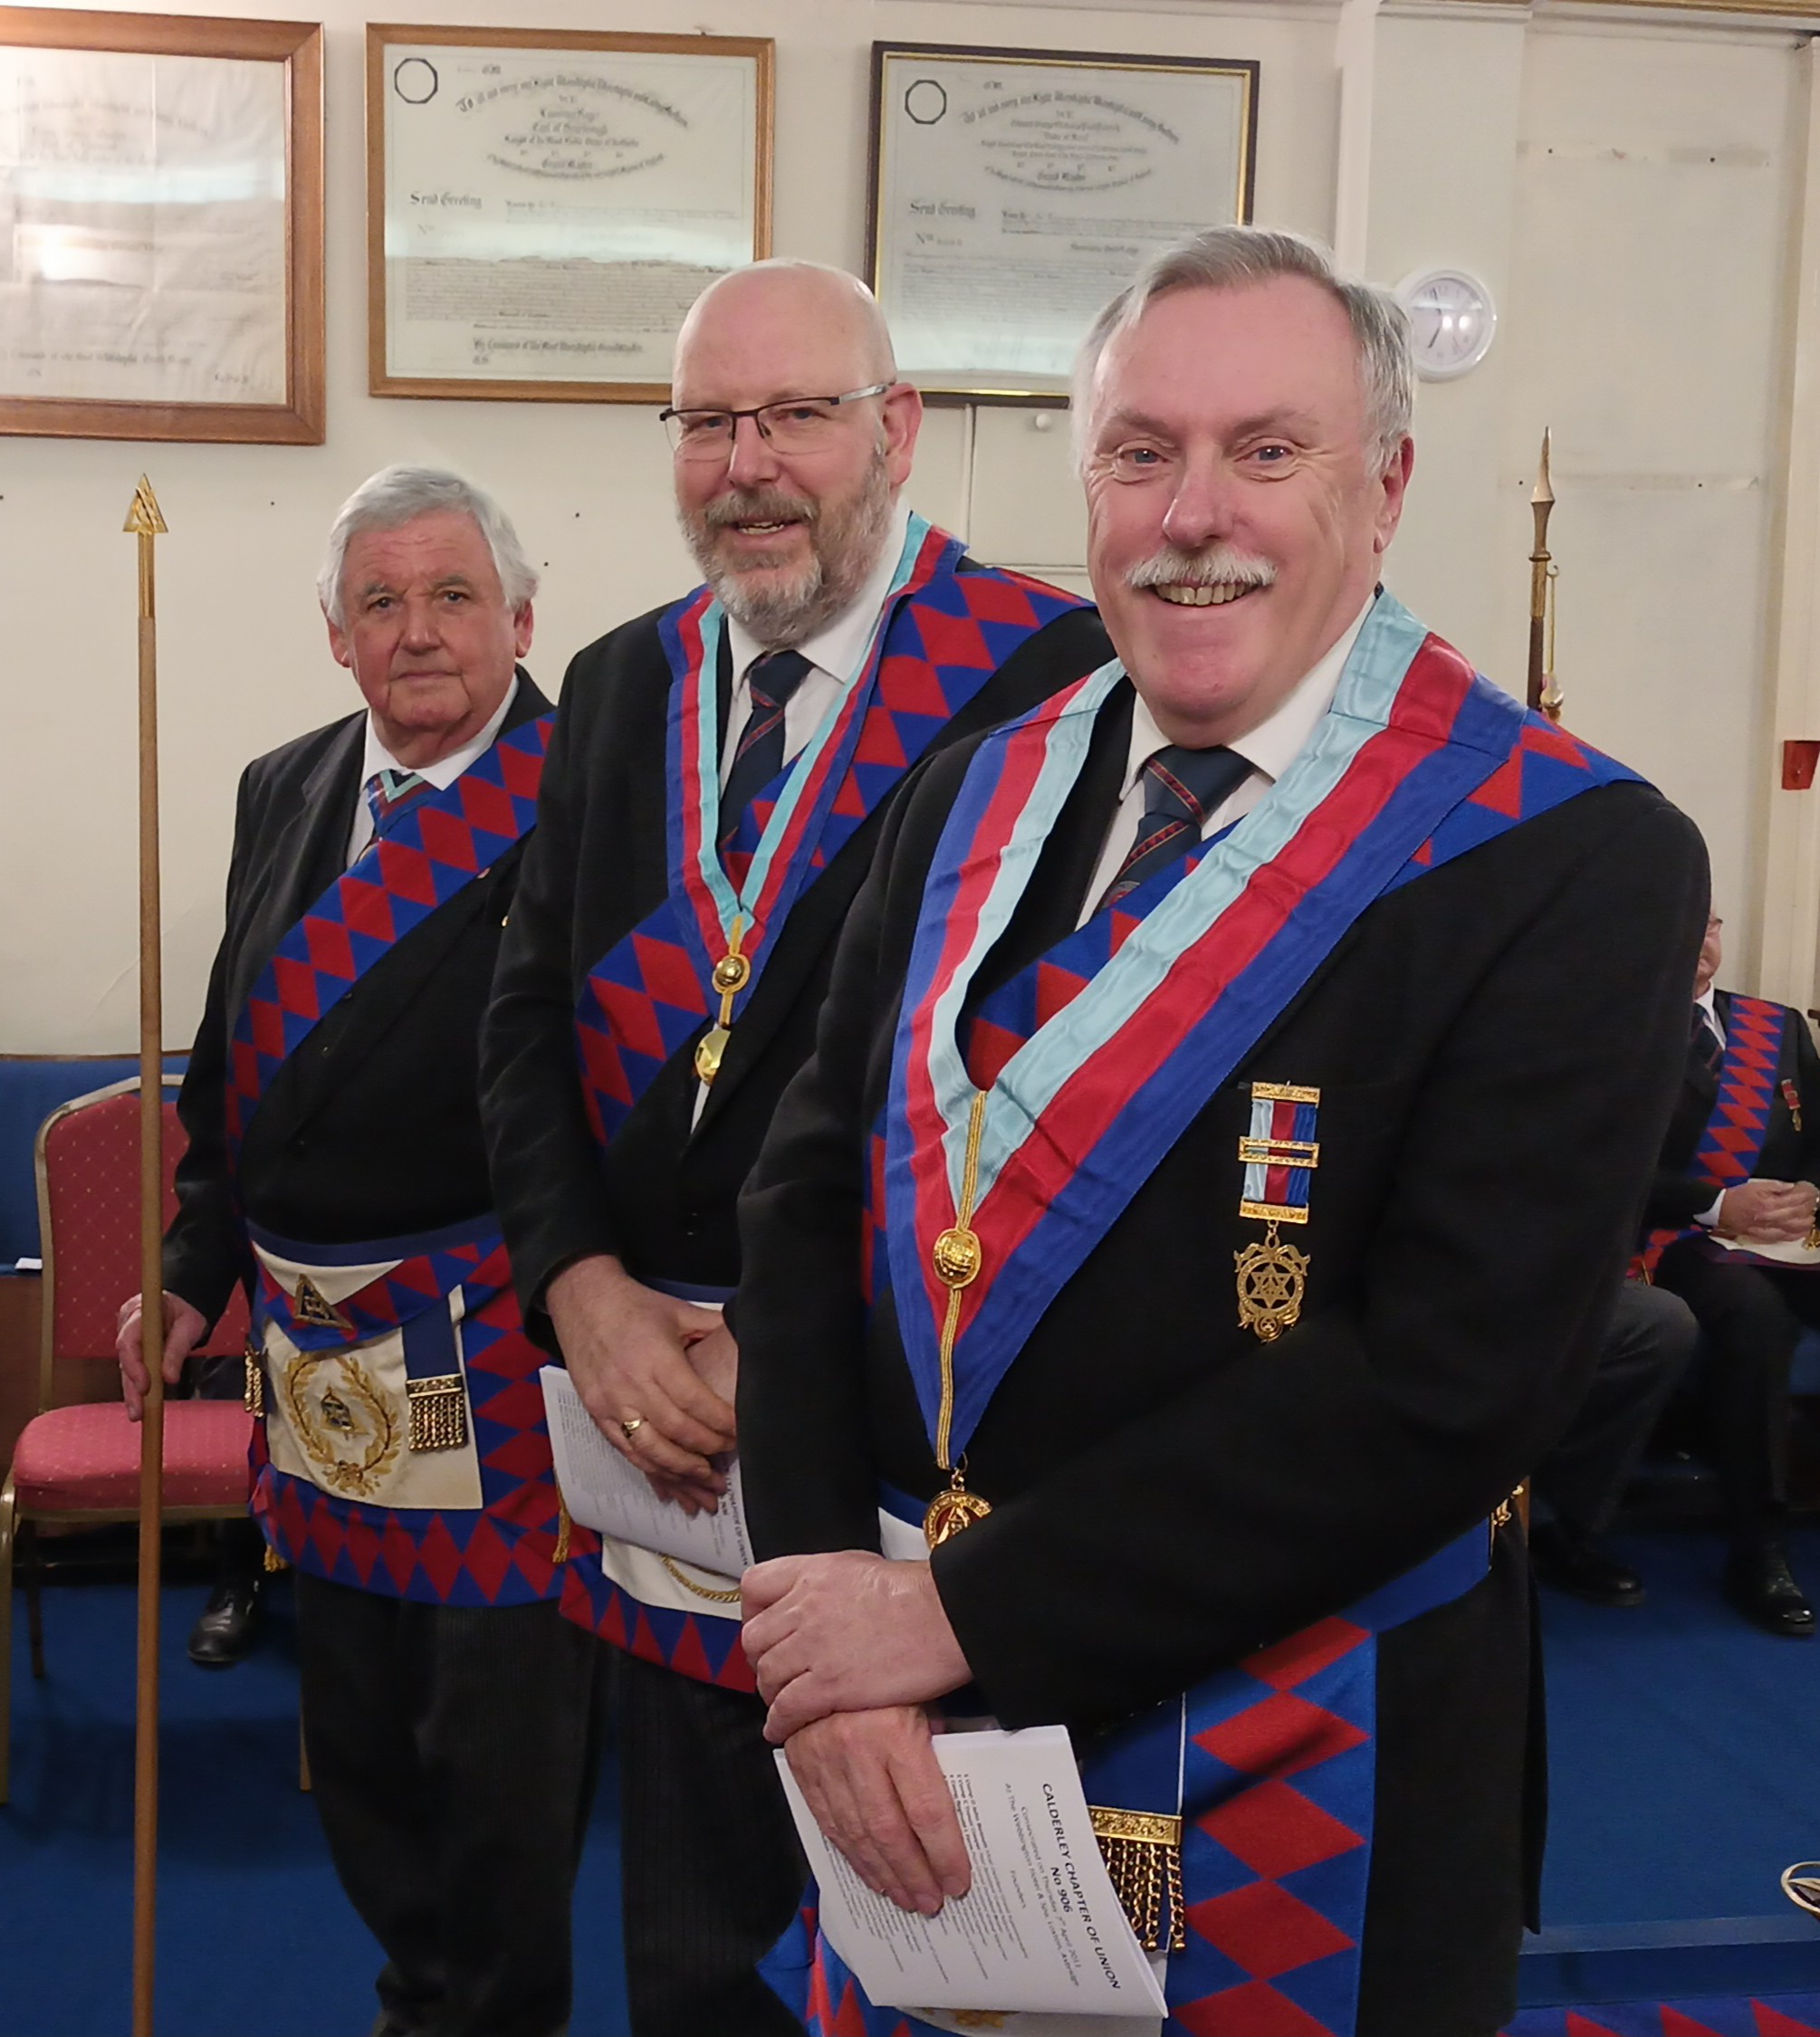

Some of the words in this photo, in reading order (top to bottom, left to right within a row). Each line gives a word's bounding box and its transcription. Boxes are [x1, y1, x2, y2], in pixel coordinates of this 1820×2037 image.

[410, 191, 438, 205] Send
[440, 191, 483, 210] Greeting
[1042, 1783, 1072, 1860] CALDERLEY
[1064, 1862, 1093, 1923] CHAPTER
[1086, 1926, 1101, 1945] OF
[1094, 1946, 1122, 1990] UNION
[1049, 1867, 1062, 1886] No
[1057, 1889, 1074, 1913] 906
